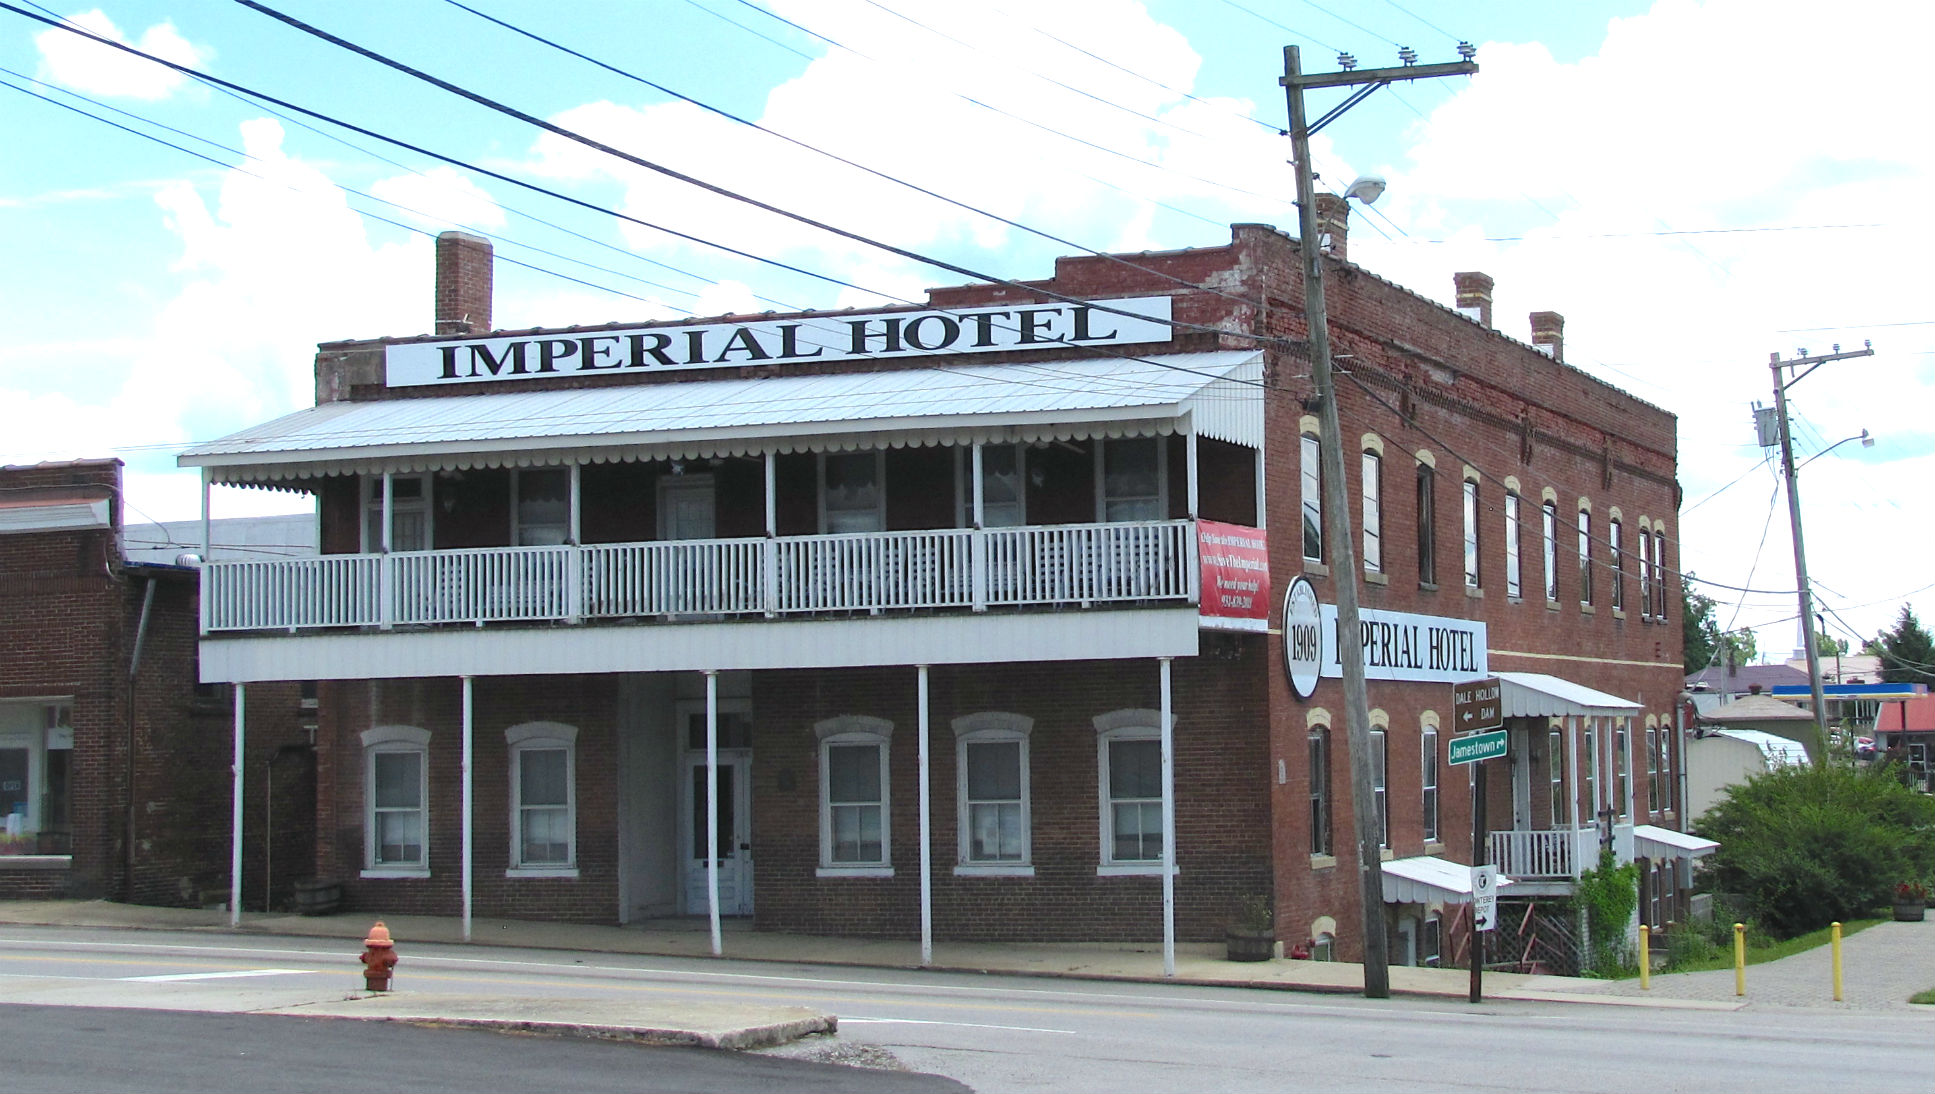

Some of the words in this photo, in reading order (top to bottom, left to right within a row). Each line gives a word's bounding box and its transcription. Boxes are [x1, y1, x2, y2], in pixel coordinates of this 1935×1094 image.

[436, 325, 823, 379] IMPERIAL
[846, 307, 1118, 355] HOTEL
[1292, 624, 1316, 661] 1909
[1334, 617, 1423, 669] IPERIAL
[1428, 627, 1478, 672] HOTEL
[1456, 691, 1472, 705] DALE
[1475, 686, 1499, 702] HOLLOW
[1481, 707, 1495, 720] DAM
[1451, 741, 1495, 760] Jamestown
